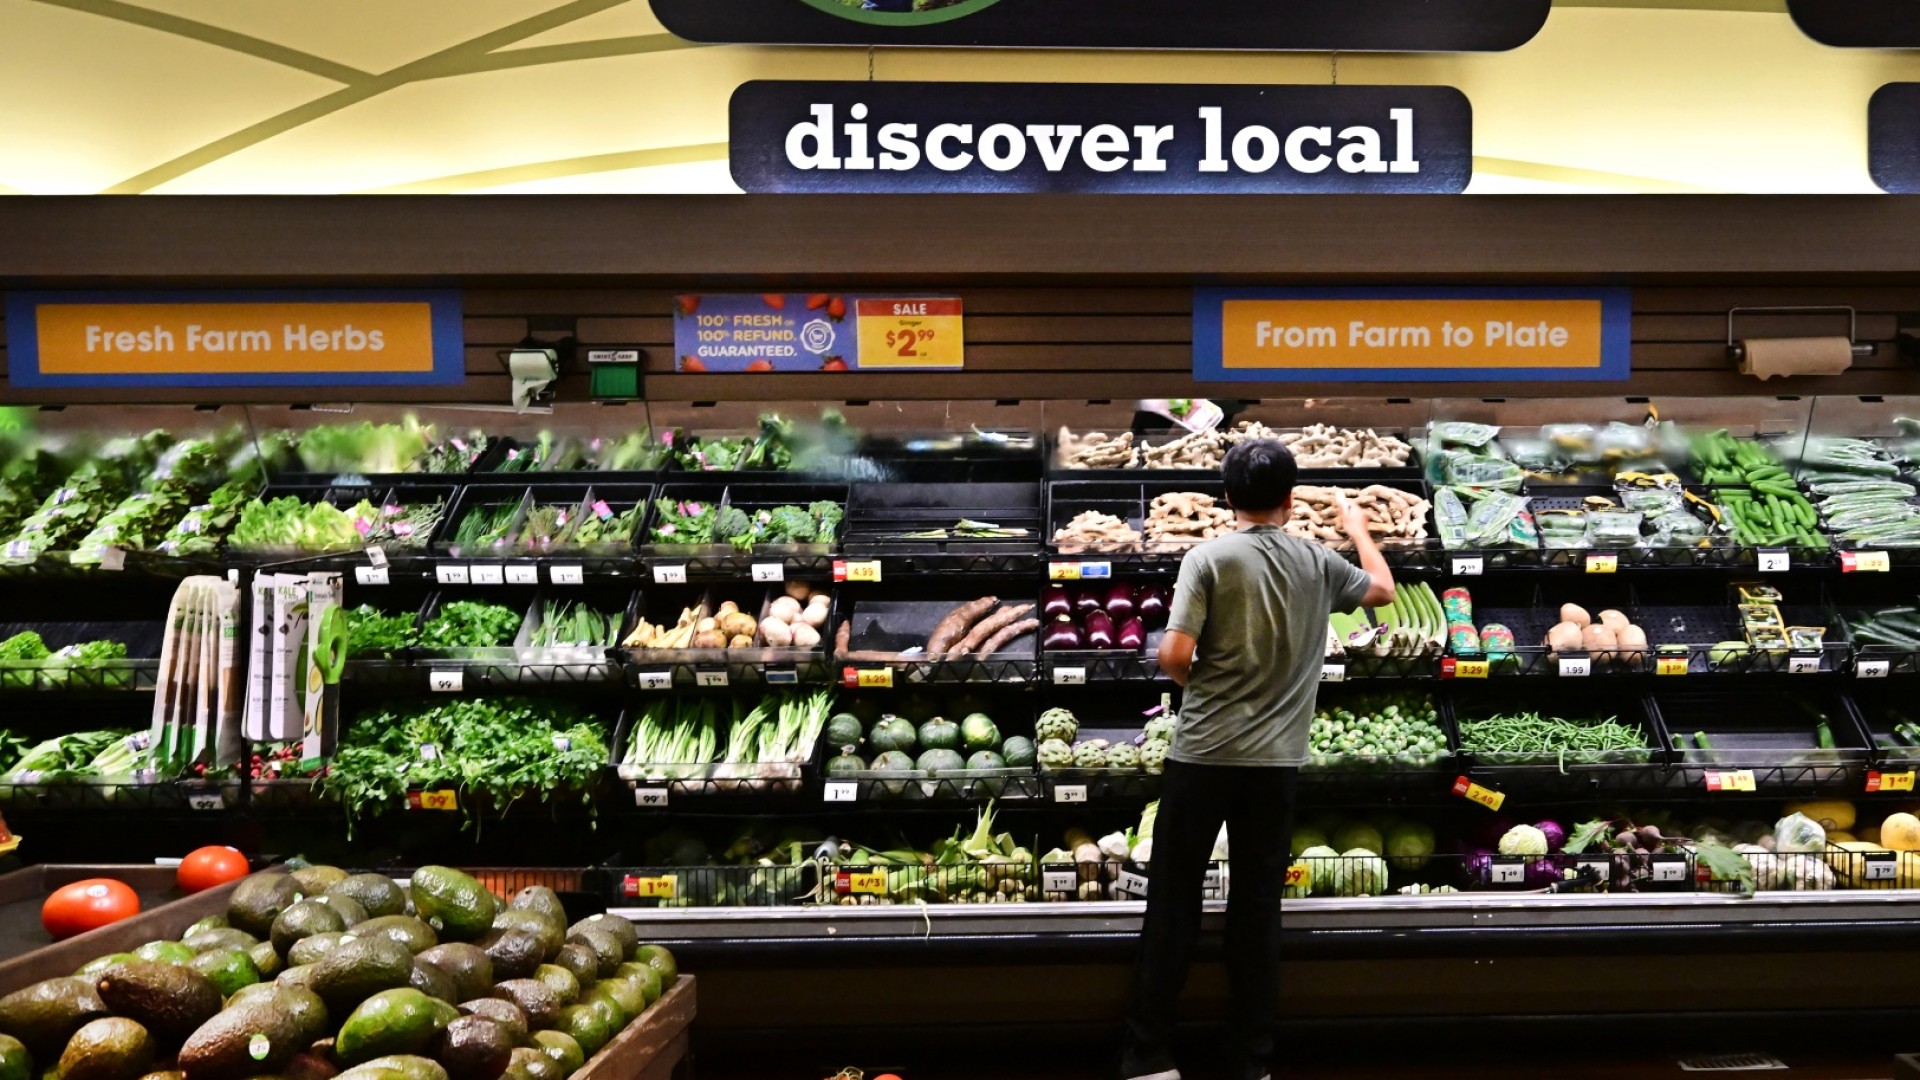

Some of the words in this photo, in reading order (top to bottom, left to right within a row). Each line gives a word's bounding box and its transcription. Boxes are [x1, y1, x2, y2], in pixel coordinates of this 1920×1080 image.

[785, 102, 1174, 172] discover
[1198, 106, 1420, 174] local
[893, 303, 927, 315] SALE
[733, 315, 782, 327] FRESH
[86, 326, 174, 351] Fresh
[187, 325, 271, 351] Farm
[284, 324, 384, 351] Herbs
[733, 329, 797, 342] REFUND.
[1256, 321, 1337, 347] From
[1348, 321, 1431, 347] Farm
[1442, 322, 1474, 347] to
[1485, 321, 1569, 347] Plate
[697, 345, 798, 357] GUARANTEED.
[853, 567, 874, 577] 4.99
[1461, 665, 1483, 674] 3.29
[1565, 667, 1584, 675] 1.99
[865, 674, 886, 684] 3.29
[1472, 790, 1494, 805] 2.49
